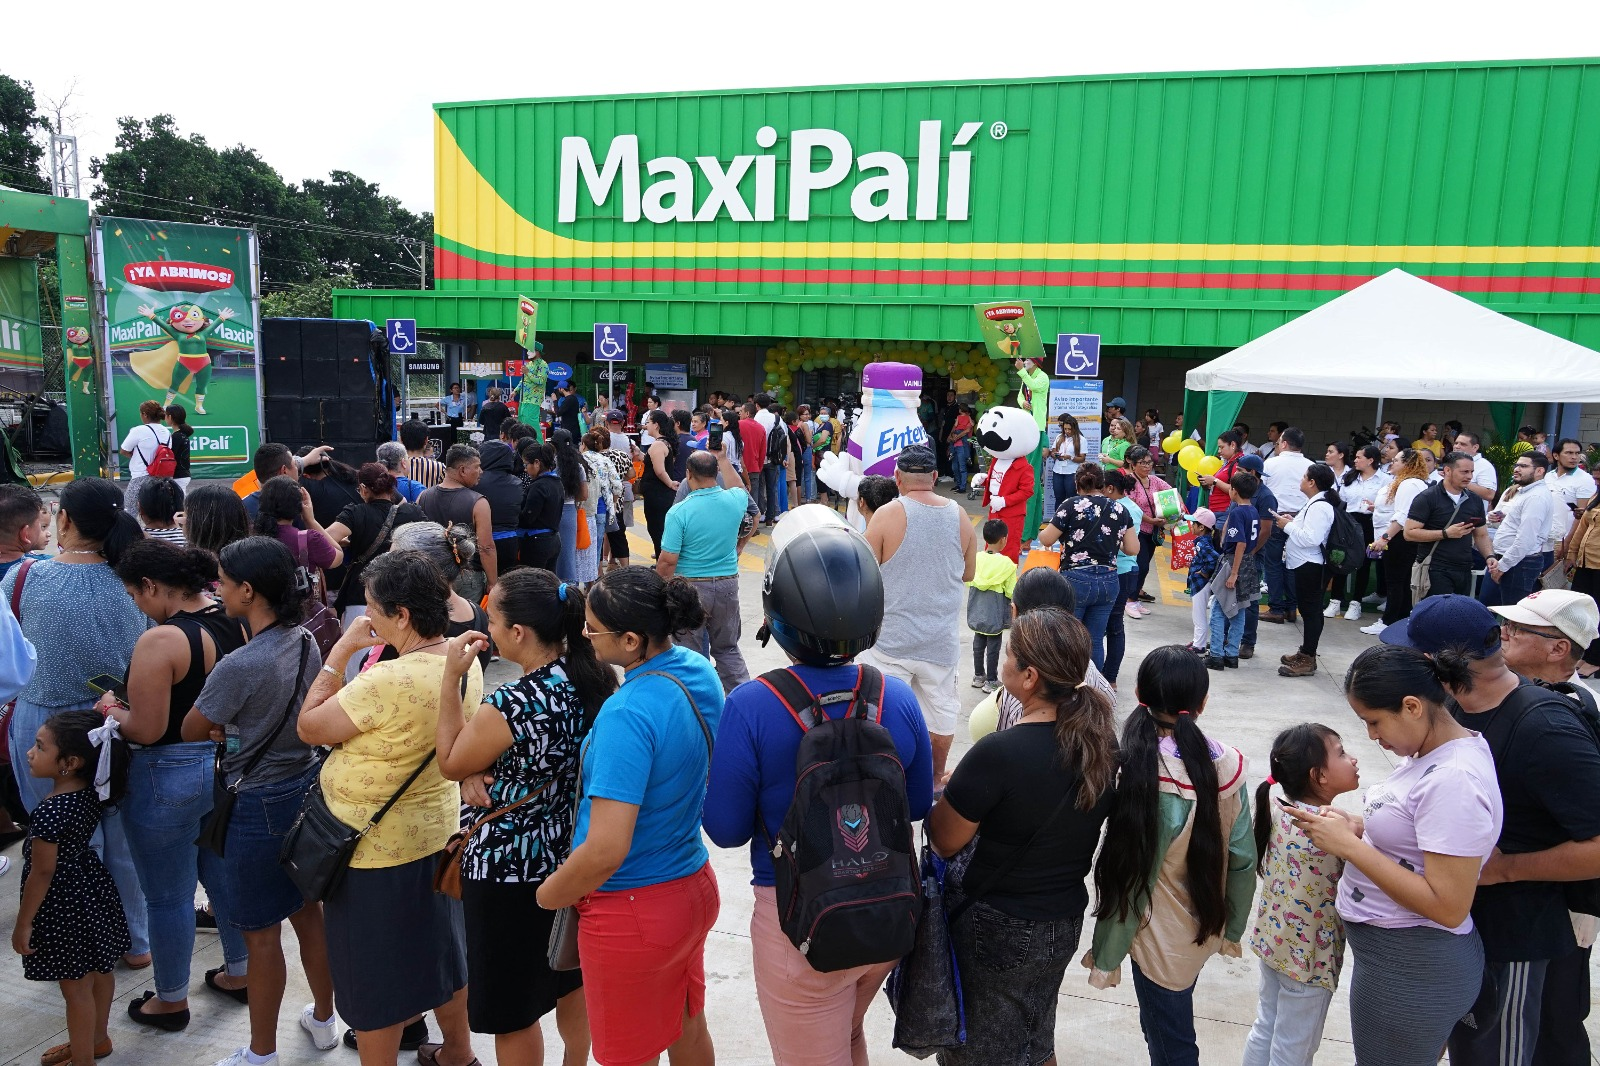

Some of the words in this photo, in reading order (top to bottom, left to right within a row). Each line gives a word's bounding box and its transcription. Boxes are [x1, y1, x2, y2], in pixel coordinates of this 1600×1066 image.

[557, 119, 983, 224] MaxiPalí
[129, 266, 155, 281] ¡YA
[160, 266, 231, 283] ABRIMOS!
[877, 425, 928, 457] Enter
[1250, 519, 1258, 540] 5
[831, 851, 889, 868] HALO
